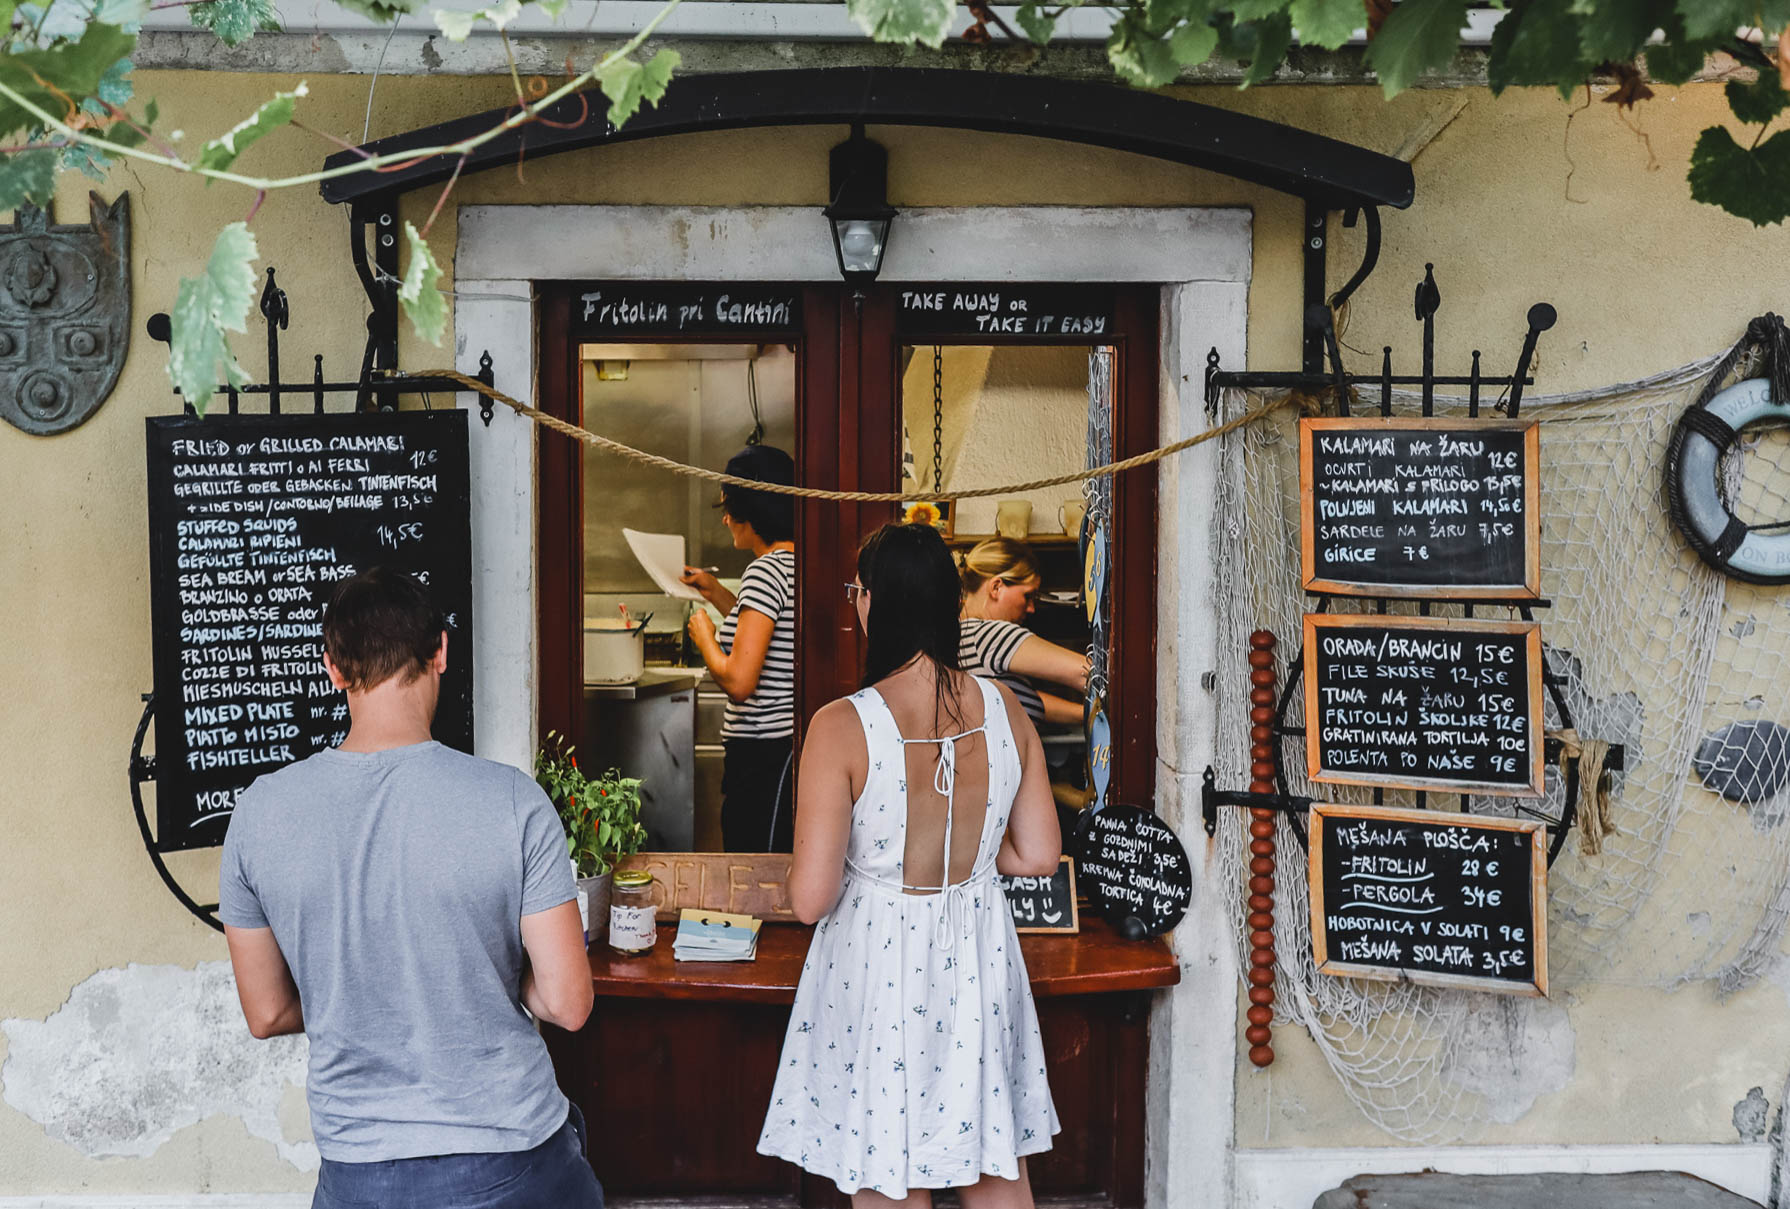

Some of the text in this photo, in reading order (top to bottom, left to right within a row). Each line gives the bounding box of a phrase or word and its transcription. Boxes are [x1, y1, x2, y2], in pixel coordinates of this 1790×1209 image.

[580, 291, 794, 330] Fritolin pri Cantini
[902, 291, 1028, 312] TAKE AWAY OR
[975, 313, 1105, 334] TAKE IT EASY
[172, 435, 405, 457] FRIED or GRILLED CALAMARI
[1320, 433, 1485, 457] KALAMARI NA ŽARU
[173, 458, 370, 478] CALAMARI FRITTI o AI FERRI
[409, 449, 438, 470] 12€
[1395, 461, 1466, 478] KALAMARI
[1487, 451, 1518, 469] 12€
[174, 474, 438, 498] GEGRILLTE ODER GEBACKEN TINTENFISCH
[1404, 481, 1417, 493] S
[1421, 478, 1480, 493] PRILOGO
[1483, 474, 1522, 495] 15,5€
[200, 500, 231, 513] SIDE
[1319, 499, 1376, 521] POLNJENI
[1393, 497, 1468, 516] KALAMARI
[176, 517, 298, 536] STUFFED SQUIDS
[377, 522, 424, 550] 14,5€
[1320, 517, 1514, 544] SARDELE NA ŽARU 7,5€
[177, 534, 302, 551] CALAMARI RIPIENI
[1324, 544, 1377, 563] GIRICE
[177, 547, 337, 569] GEFÜLLTE TINTENFISCH
[178, 564, 357, 588] SEA BREAM or SEA BASS
[179, 585, 313, 605] BRANZINO o ORATA
[181, 606, 280, 625] GOLDBRASSE
[287, 607, 319, 621] oder
[181, 645, 253, 665] FRITOLIN
[1475, 643, 1514, 664] 15€
[182, 665, 231, 681] COZZE
[236, 664, 256, 678] DI
[1328, 660, 1509, 688] FILE SKUŠE 12,5€
[183, 680, 303, 702] MIESMUSCHELN
[1322, 687, 1368, 705] TUNA
[1381, 688, 1408, 707] NA
[1478, 692, 1515, 713] 15€
[184, 704, 243, 726] MIXED
[246, 701, 295, 722] PLATE
[1326, 707, 1527, 733] FRITOLIN ŠKOLJKE 12€
[184, 723, 301, 747] PIATTO MISTO
[1323, 727, 1526, 752] GRATINIRANA TORTILJA 10€
[186, 745, 296, 771] FISHTELLER
[1092, 743, 1110, 769] 14
[1327, 748, 1517, 772] POLENTA PO NAŠE 9€
[1095, 815, 1174, 844] PANNA COTTA
[1336, 821, 1407, 848] MEŠANA
[1099, 882, 1144, 906] TORTICA
[1461, 885, 1503, 908] 34€
[1007, 897, 1036, 922] LY
[1328, 915, 1526, 942] HOBOTNICA V SOLATI 9€
[1340, 934, 1526, 975] MEŠANA SOLATA 3,5€
